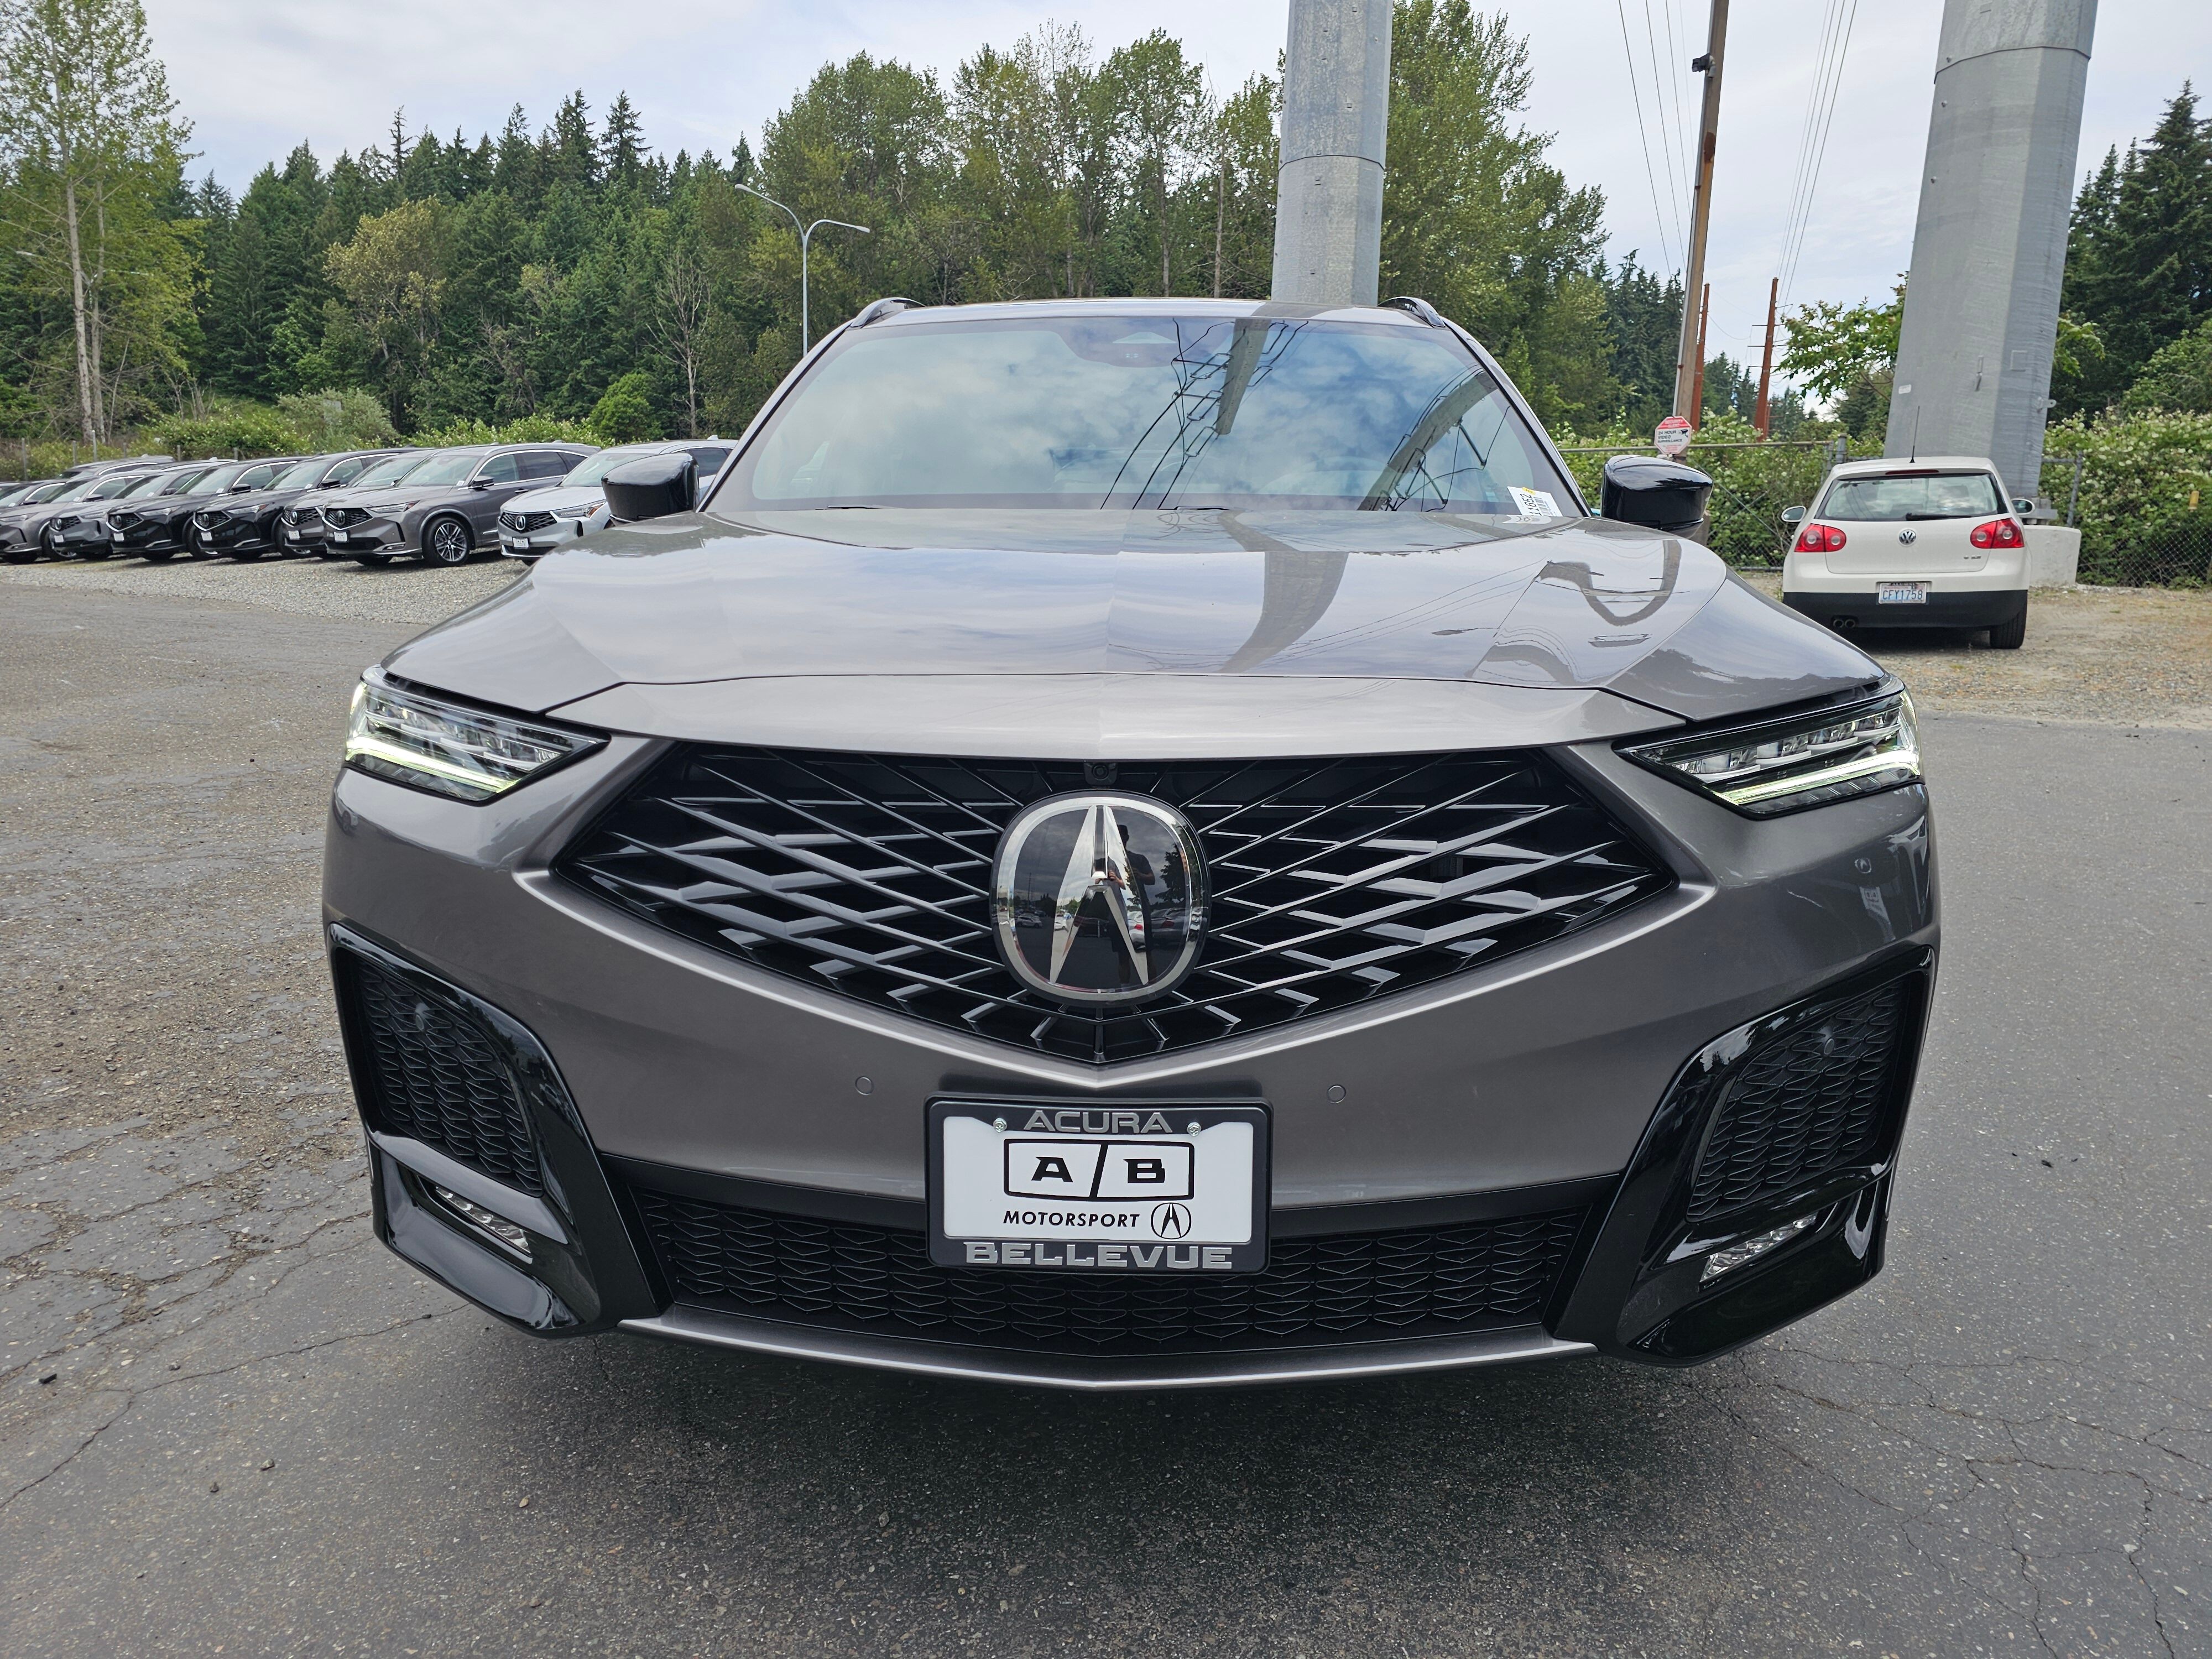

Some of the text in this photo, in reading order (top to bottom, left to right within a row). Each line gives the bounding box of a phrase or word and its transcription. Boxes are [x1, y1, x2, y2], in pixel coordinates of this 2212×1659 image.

[1520, 493, 1542, 516] 11652
[1883, 590, 1923, 600] CFY1758
[1023, 1110, 1172, 1135] ACURA
[1003, 1211, 1140, 1228] MOTORSPORT
[963, 1241, 1233, 1269] BELLEVUE
